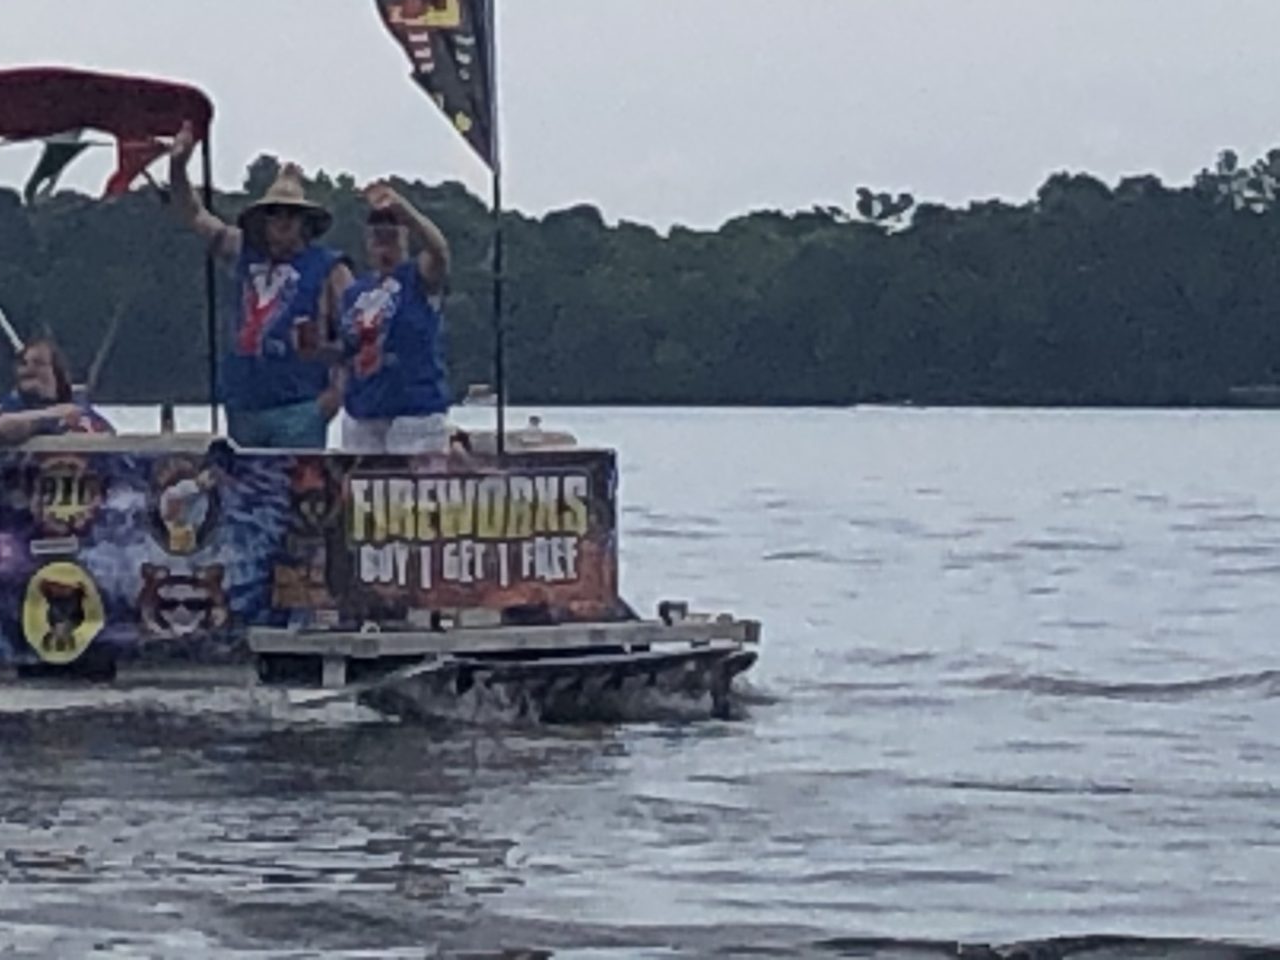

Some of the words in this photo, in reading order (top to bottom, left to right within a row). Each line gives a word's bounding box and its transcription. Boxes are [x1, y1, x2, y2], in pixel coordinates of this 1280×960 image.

[350, 476, 588, 540] FIREWORKS
[360, 541, 409, 586] BUY
[442, 540, 486, 583] GET
[522, 536, 578, 582] FREE
